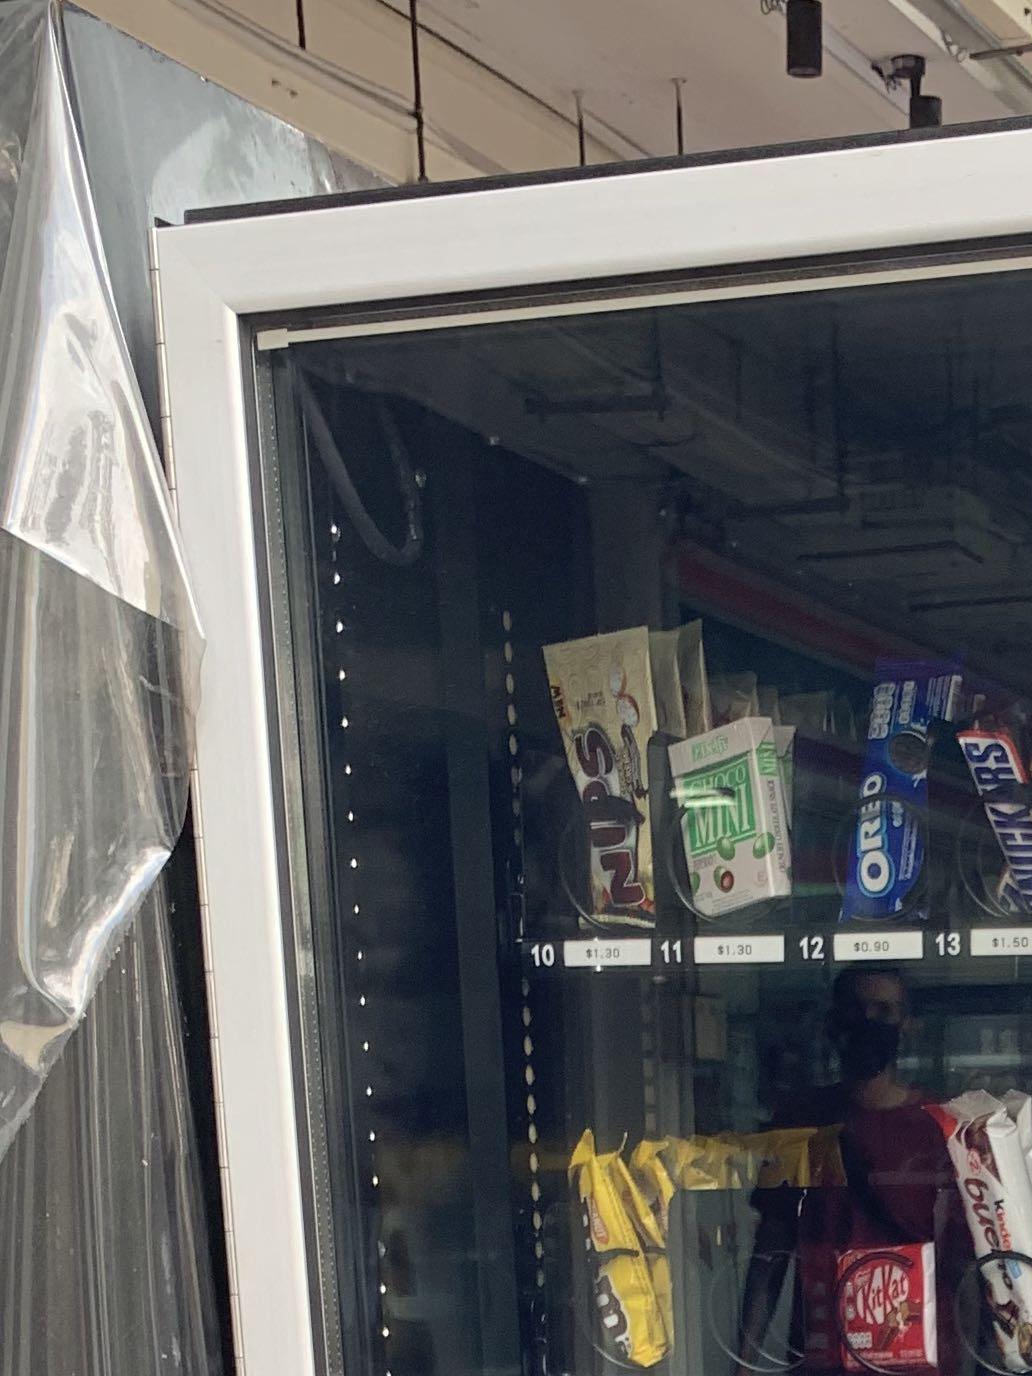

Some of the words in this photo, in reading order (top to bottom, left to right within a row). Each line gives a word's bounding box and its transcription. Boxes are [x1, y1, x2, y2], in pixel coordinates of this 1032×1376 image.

[860, 775, 891, 893] OREO
[660, 940, 682, 963] 11
[717, 944, 752, 956] $1.30
[800, 936, 825, 961] 12
[936, 933, 961, 956] 13
[992, 936, 1029, 949] $1.50
[531, 944, 554, 967] 10
[857, 1264, 909, 1325] KitKat
